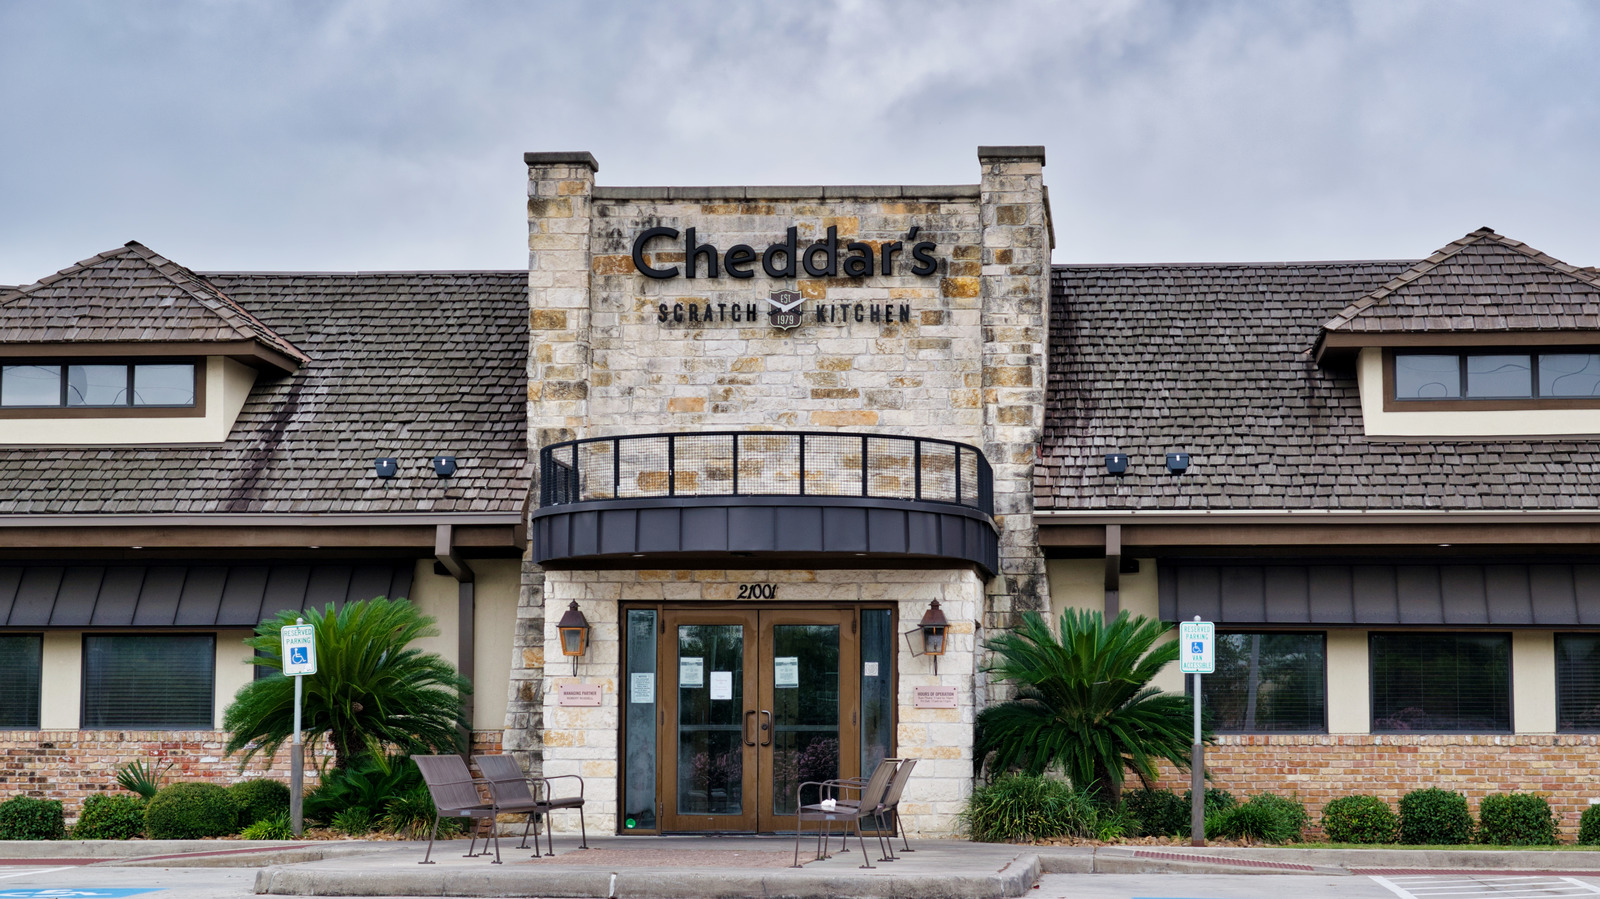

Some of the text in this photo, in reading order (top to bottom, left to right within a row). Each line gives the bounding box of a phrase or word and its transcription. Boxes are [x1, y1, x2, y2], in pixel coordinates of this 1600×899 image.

[632, 225, 937, 279] Cheddar's
[780, 294, 791, 304] EST
[658, 303, 757, 322] SCRATCH
[816, 303, 910, 322] KITCHEN
[777, 315, 794, 325] 1979
[737, 584, 777, 599] 21001
[284, 629, 312, 637] RESERVED
[286, 637, 311, 645] PARKING
